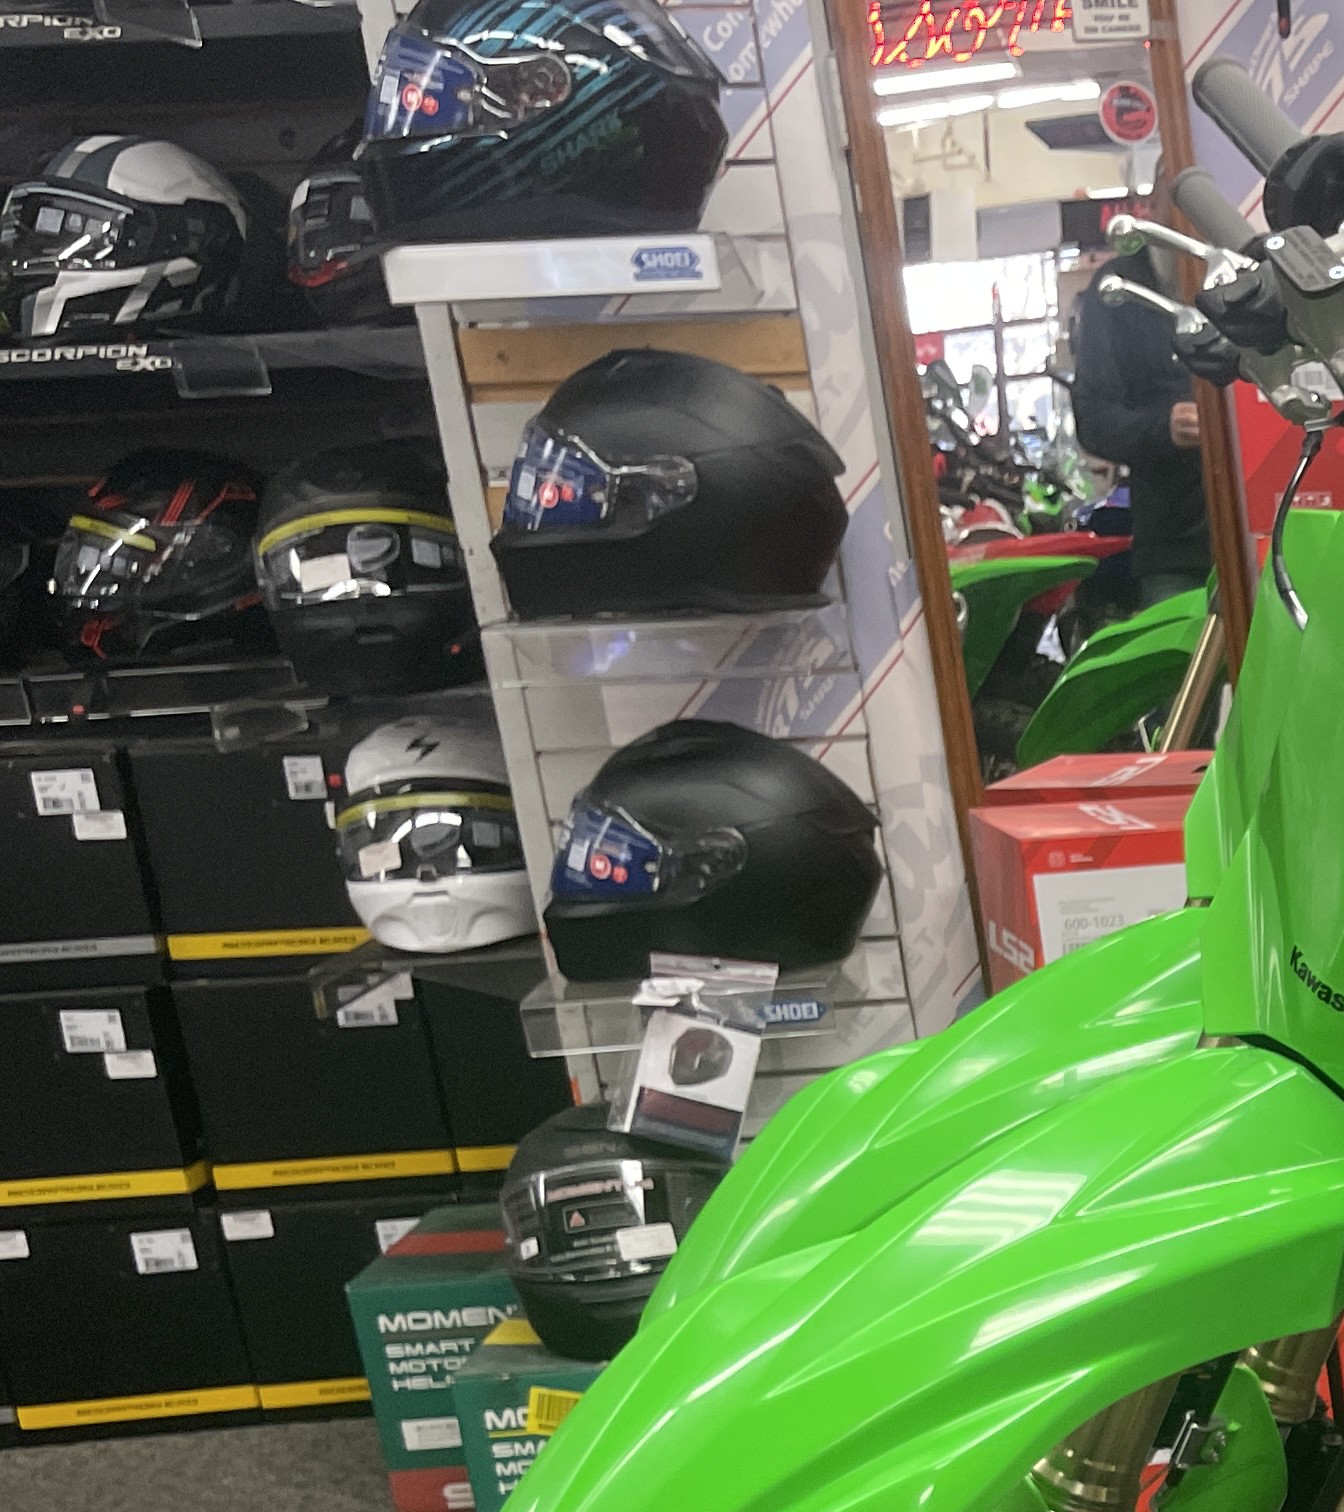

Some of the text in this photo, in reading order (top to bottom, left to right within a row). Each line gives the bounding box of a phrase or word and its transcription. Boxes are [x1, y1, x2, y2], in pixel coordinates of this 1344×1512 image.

[640, 251, 691, 270] SHOEI
[116, 355, 173, 372] EXO
[1064, 914, 1125, 932] 600-1023
[989, 919, 1036, 975] LS2
[377, 1303, 518, 1333] MOMEN
[385, 1338, 475, 1358] SMART
